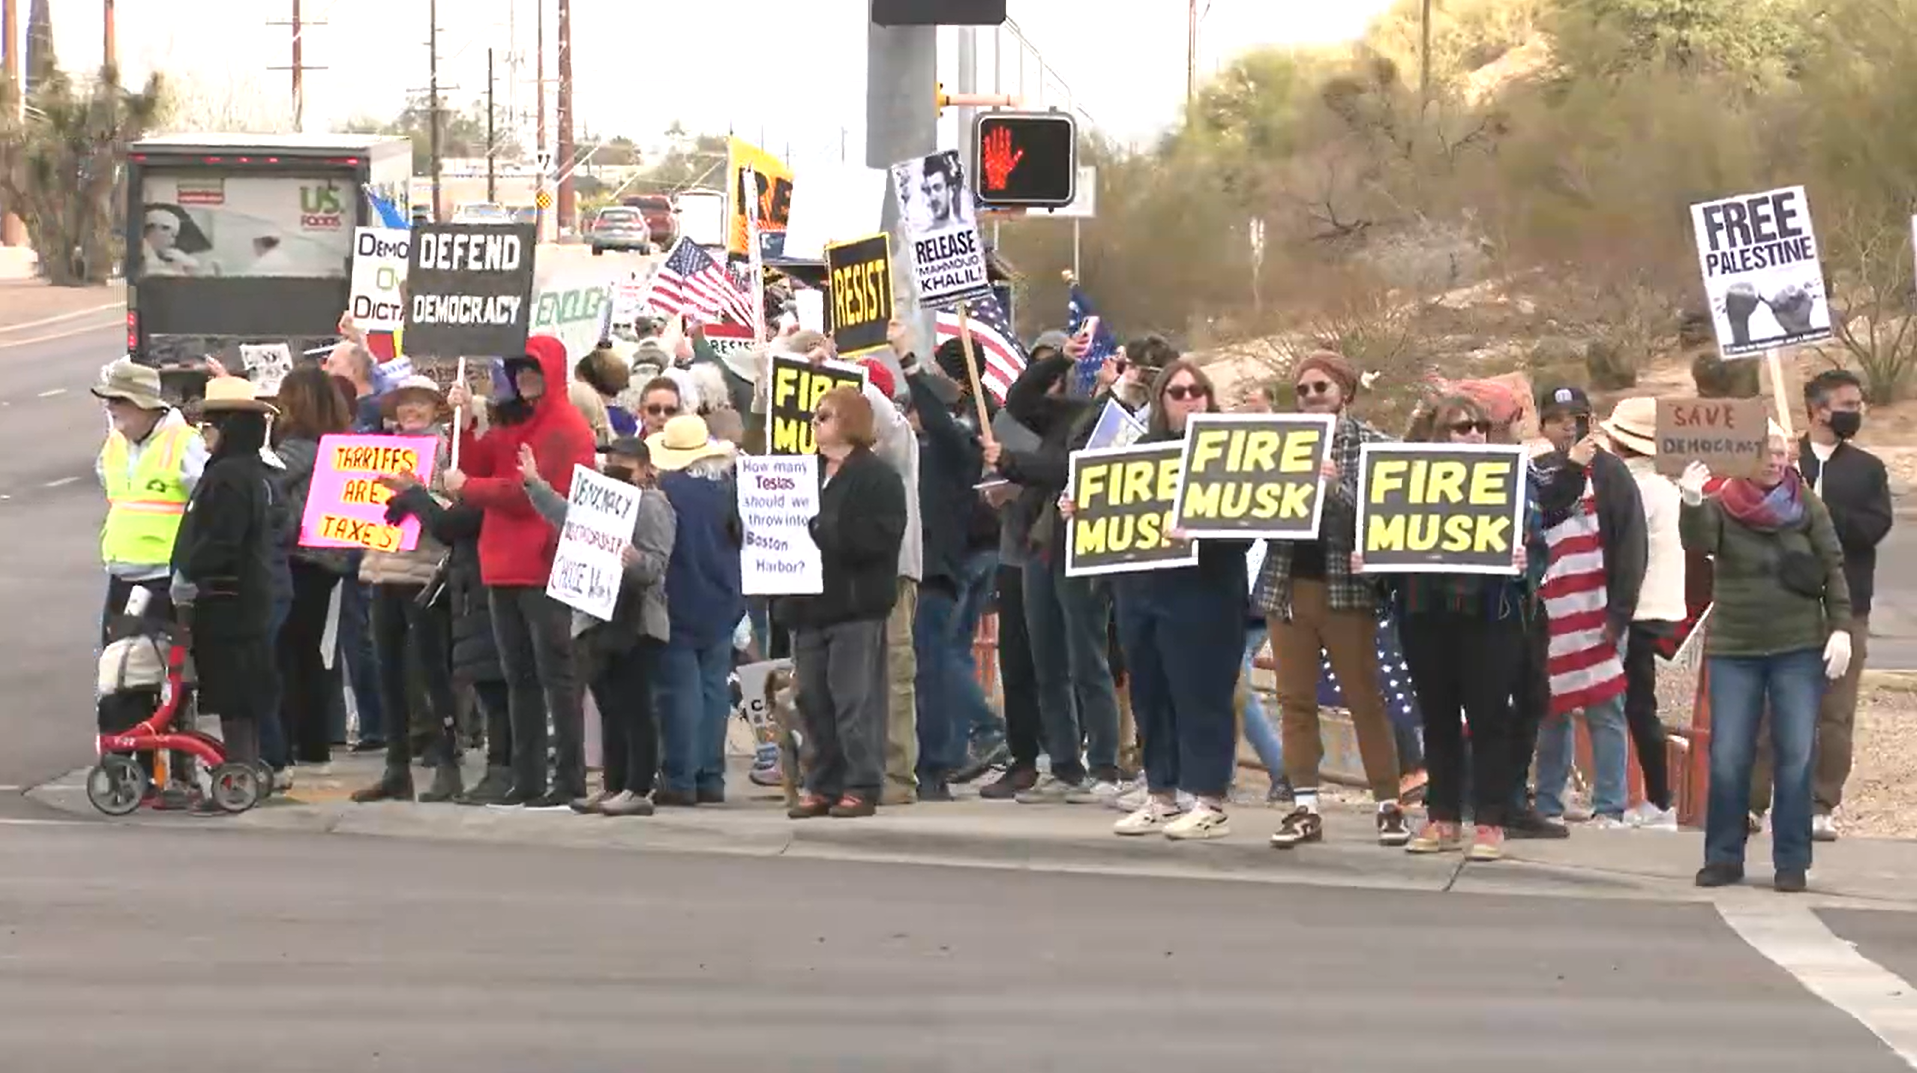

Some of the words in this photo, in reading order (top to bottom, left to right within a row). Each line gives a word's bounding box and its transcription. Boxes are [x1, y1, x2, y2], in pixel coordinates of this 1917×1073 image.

[737, 167, 793, 227] RE
[1703, 191, 1803, 251] FREE
[358, 233, 410, 259] DEMO
[419, 233, 521, 271] DEFEND
[915, 230, 976, 265] RELEASE
[1706, 236, 1815, 278] PALESTINE
[412, 294, 521, 324] DEMOCRACY
[833, 259, 886, 329] RESIST
[709, 339, 756, 354] RESIS
[775, 367, 860, 414] FIR
[1673, 403, 1735, 430] SAVE
[774, 416, 818, 455] MU
[1191, 430, 1320, 473] FIRE
[337, 447, 414, 472] TARRIFFS
[743, 460, 768, 473] How
[774, 461, 807, 475] many
[343, 480, 381, 505] ARE
[755, 475, 796, 491] Teslas
[1078, 458, 1181, 509] FIRE
[1370, 460, 1511, 505] FIRE
[742, 494, 785, 508] should
[1182, 482, 1315, 519] MUSK
[323, 516, 392, 548] TAXES
[746, 531, 788, 551] Boston
[1367, 514, 1511, 552] MUSK
[756, 559, 806, 573] Harbor?
